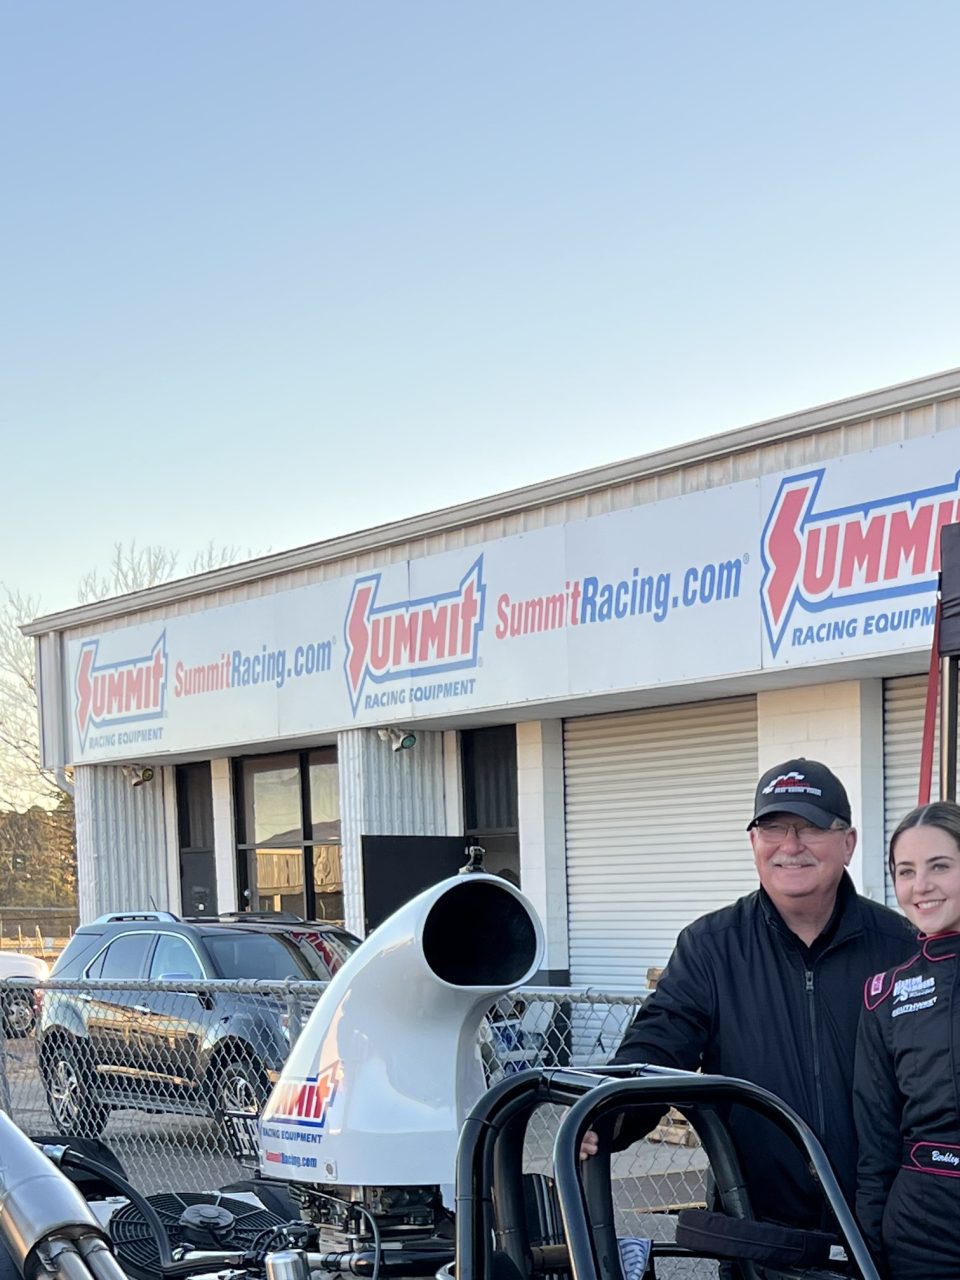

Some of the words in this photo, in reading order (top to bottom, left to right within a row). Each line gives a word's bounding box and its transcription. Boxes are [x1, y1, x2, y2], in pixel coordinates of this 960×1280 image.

[496, 558, 741, 639] SummitRacing.com
[349, 579, 477, 693] SUMMIT
[791, 619, 857, 646] RACING
[863, 605, 936, 635] EQUIPM
[78, 648, 164, 732] SUMMIT
[174, 639, 331, 698] SummitRacing.com
[364, 690, 406, 709] RACING
[409, 678, 476, 702] EQUIPMENT
[89, 732, 116, 749] RACING
[117, 727, 163, 744] EQUIPMENT
[281, 1131, 323, 1144] EQUIPMENT
